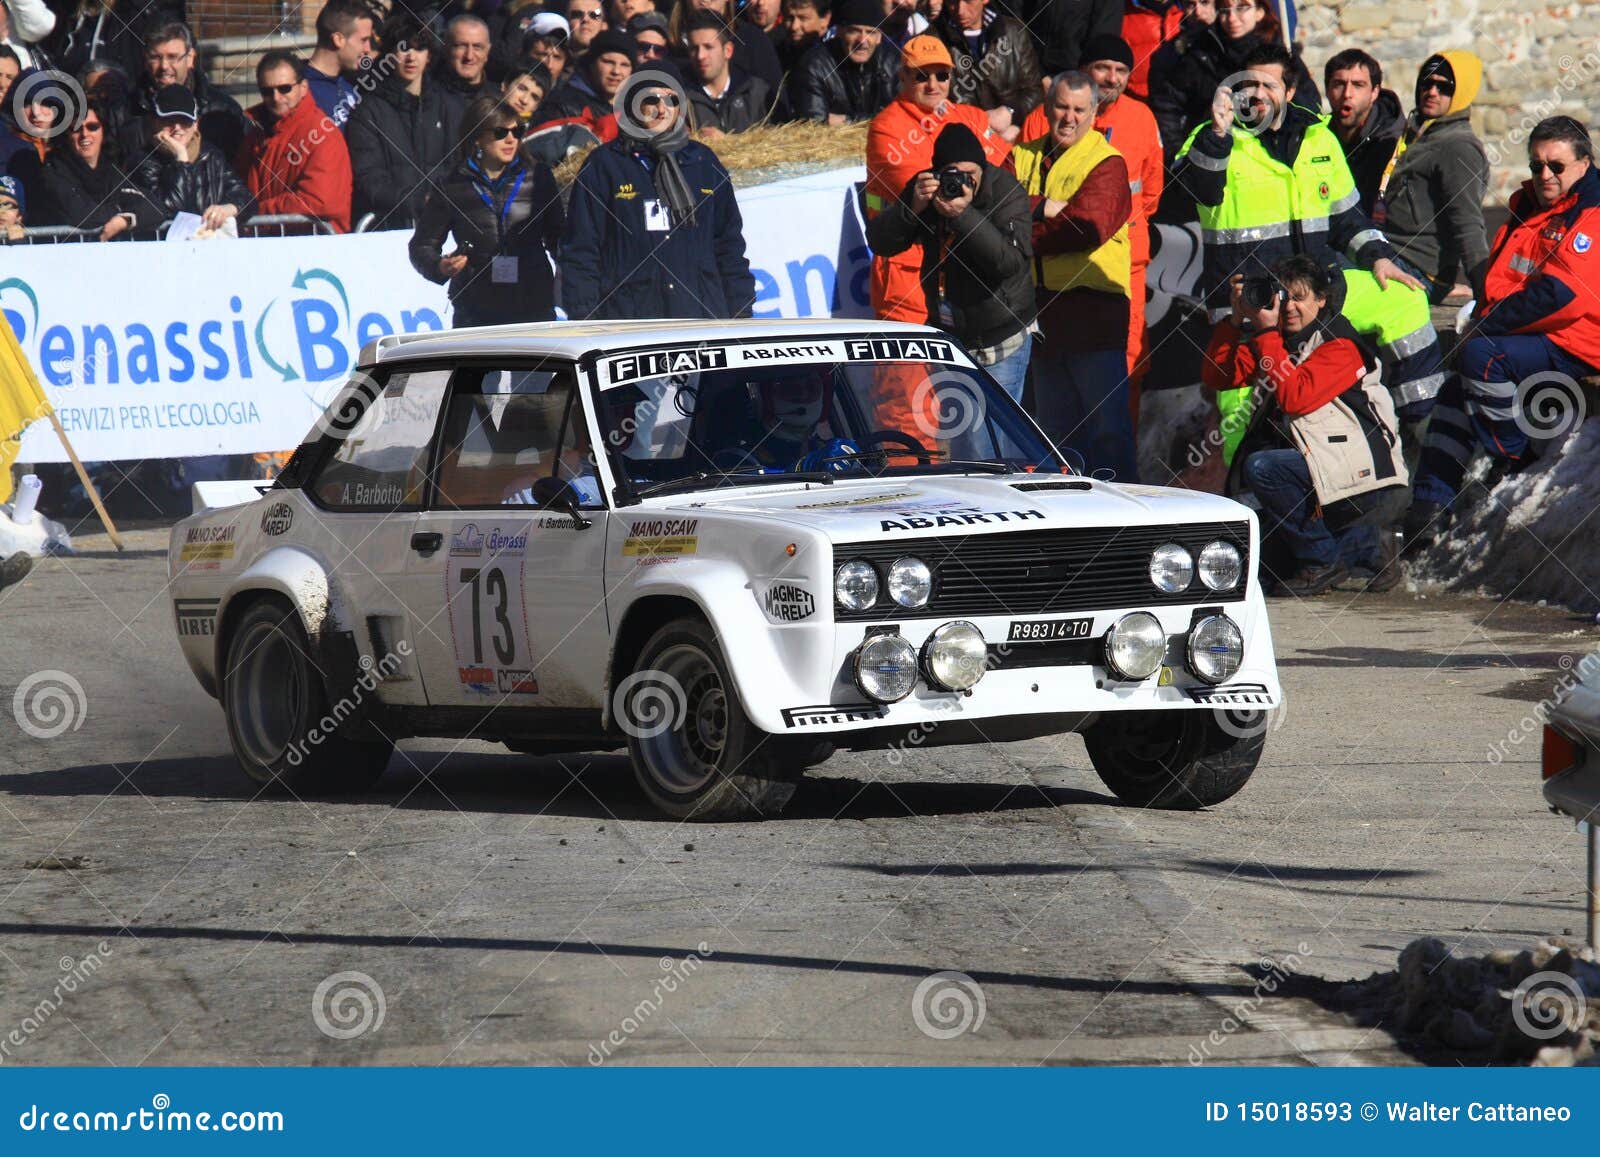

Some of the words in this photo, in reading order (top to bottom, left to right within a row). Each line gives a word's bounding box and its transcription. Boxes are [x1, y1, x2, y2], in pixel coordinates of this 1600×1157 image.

[613, 349, 726, 383] FIAT
[741, 345, 834, 361] ABARTH
[847, 340, 953, 361] FIAT
[120, 404, 152, 428] PER
[154, 400, 261, 428] L'ECOLOGIA
[355, 484, 403, 504] Barbotto
[629, 521, 662, 538] MANO
[663, 519, 698, 536] SCAVI
[880, 509, 1046, 532] ABARTH
[489, 532, 528, 549] Benassi
[765, 585, 815, 606] MAGNETI
[460, 567, 515, 666] 73
[765, 600, 815, 621] MARELLI
[1184, 682, 1274, 705] PIRELLI
[780, 702, 885, 729] PIRELLI
